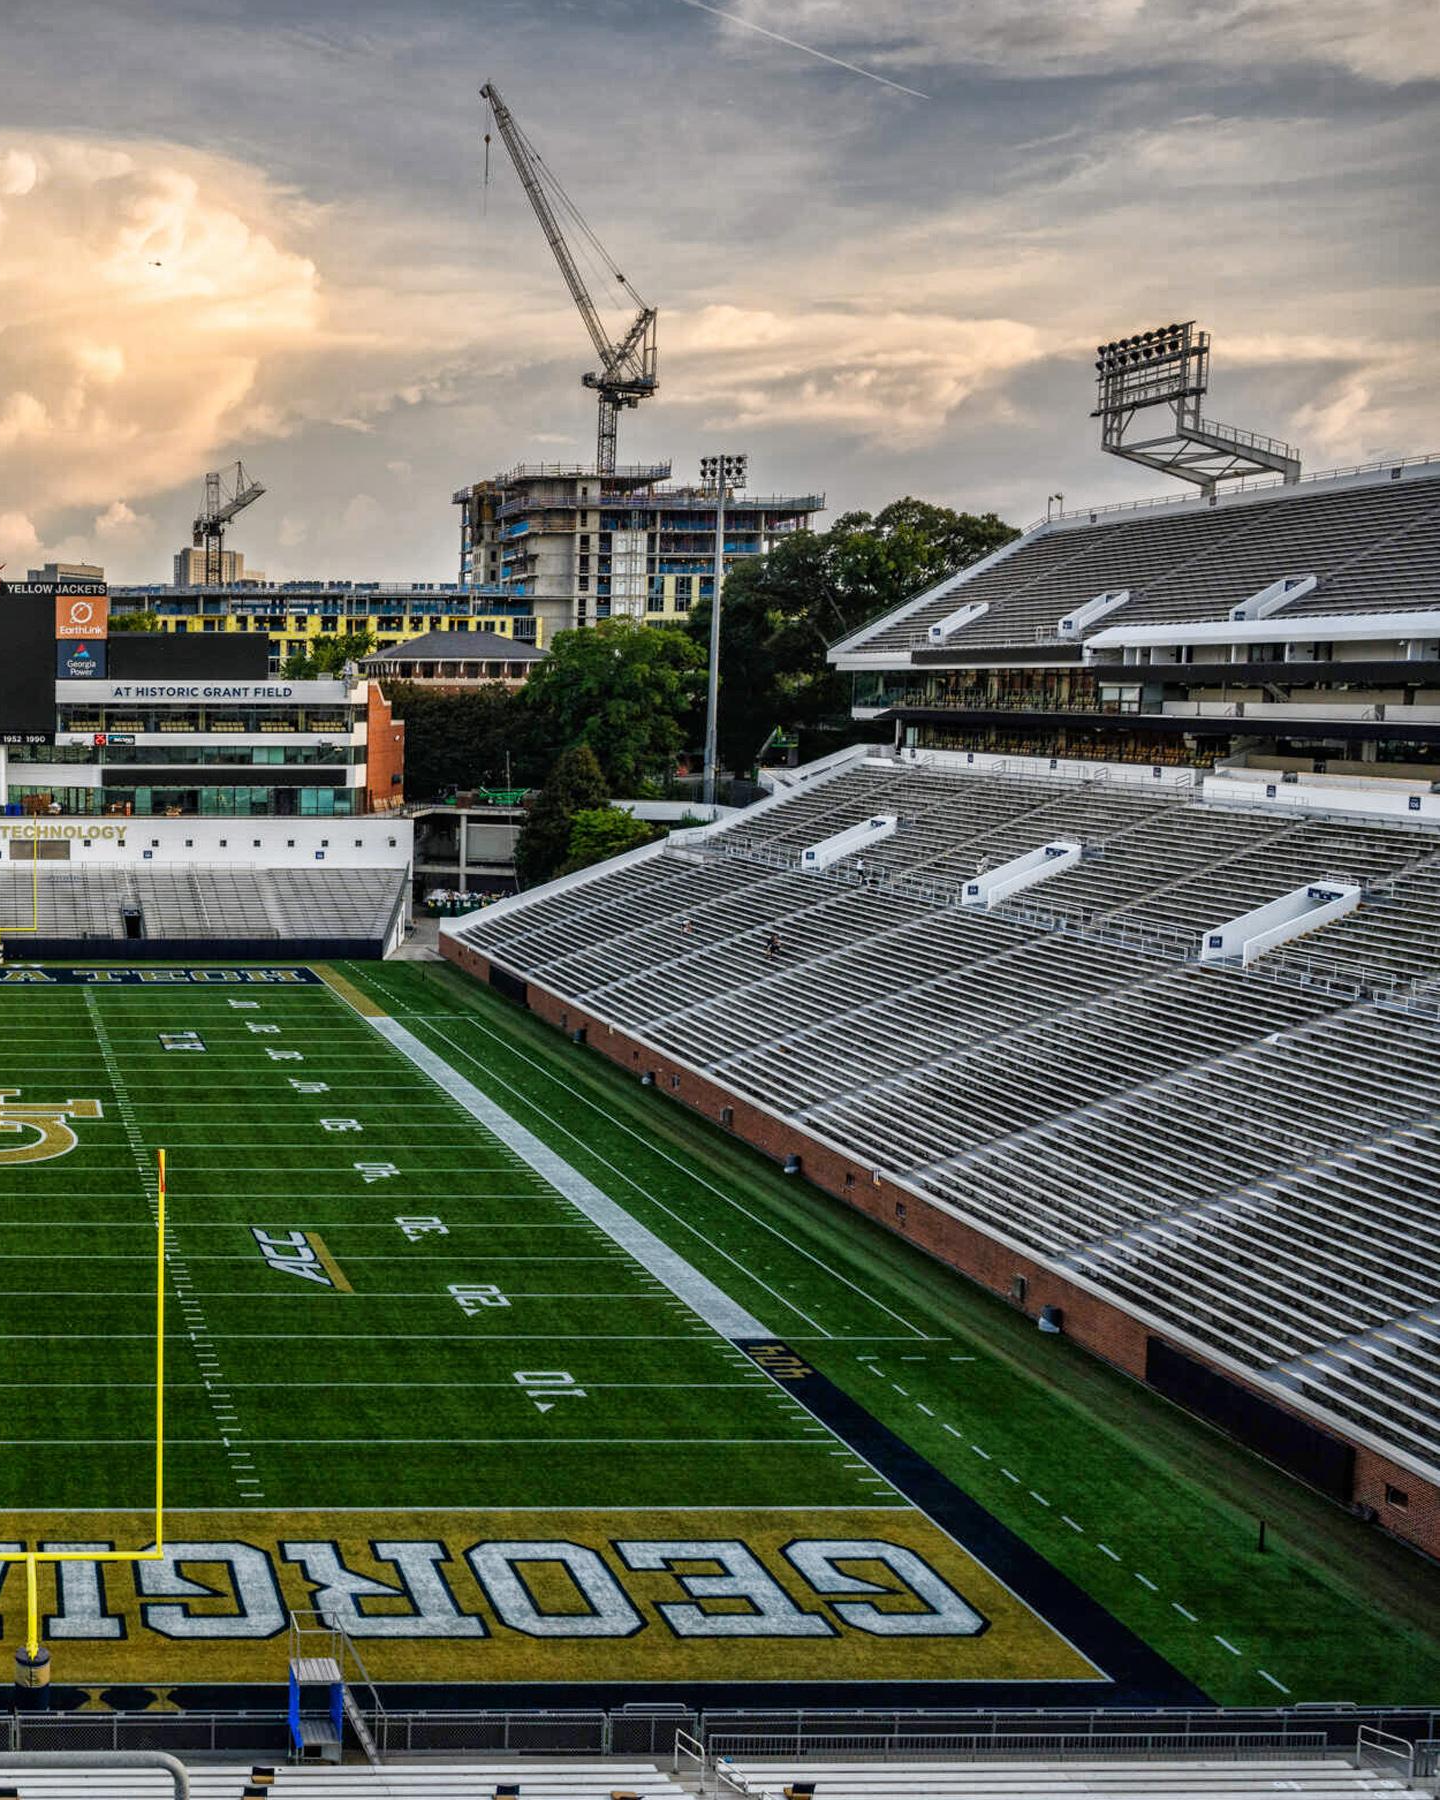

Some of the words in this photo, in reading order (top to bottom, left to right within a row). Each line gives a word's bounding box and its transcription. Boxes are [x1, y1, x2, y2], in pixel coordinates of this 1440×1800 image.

[7, 584, 53, 594] YELLOW
[55, 584, 106, 594] JACKETS
[59, 625, 103, 635] EarthLink
[66, 660, 97, 670] Georgia
[70, 668, 94, 676] Power
[114, 687, 132, 697] AT
[136, 687, 199, 697] HISTORIC
[203, 687, 250, 697] GRANT
[254, 687, 292, 697] FIELD
[3, 735, 22, 743] 1952
[26, 735, 46, 743] 1990
[0, 824, 128, 839] TECHNOLOGY
[72, 969, 308, 982] TECH
[158, 1030, 208, 1053] ATL
[249, 1226, 335, 1288] ACC
[747, 1346, 814, 1378] 404
